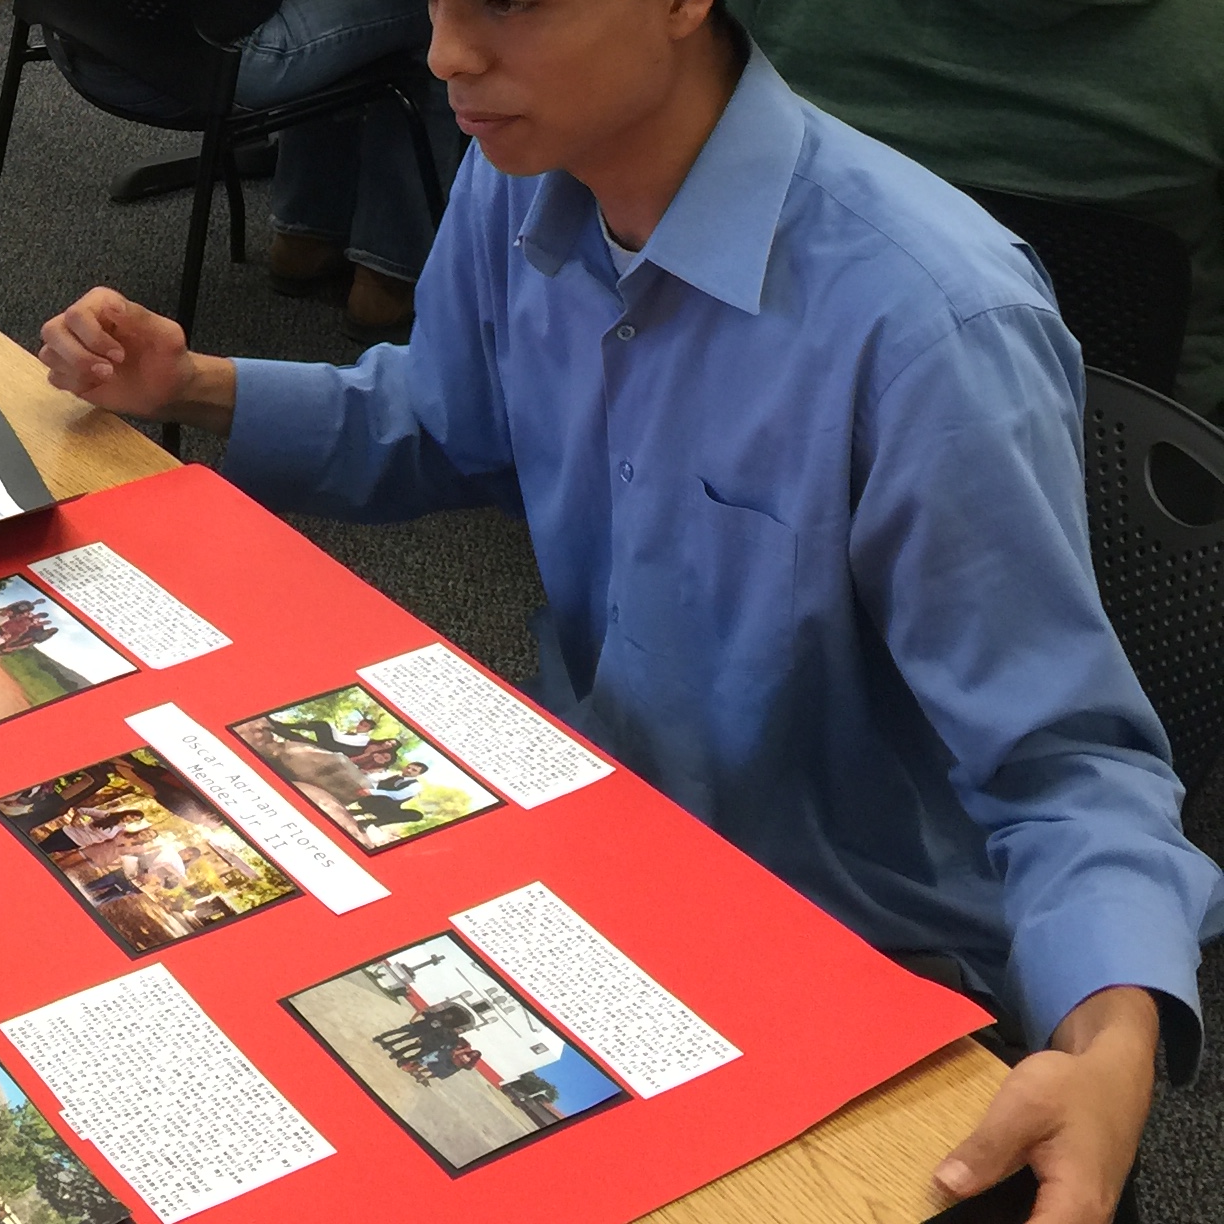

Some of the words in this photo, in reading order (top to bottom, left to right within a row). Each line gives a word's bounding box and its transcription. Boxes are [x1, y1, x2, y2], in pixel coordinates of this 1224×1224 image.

[181, 735, 224, 767] Oscar
[225, 774, 278, 818] Adrian
[280, 822, 335, 868] Flores
[186, 763, 238, 807] Mendez
[239, 814, 262, 826] Jr
[263, 833, 289, 850] II
